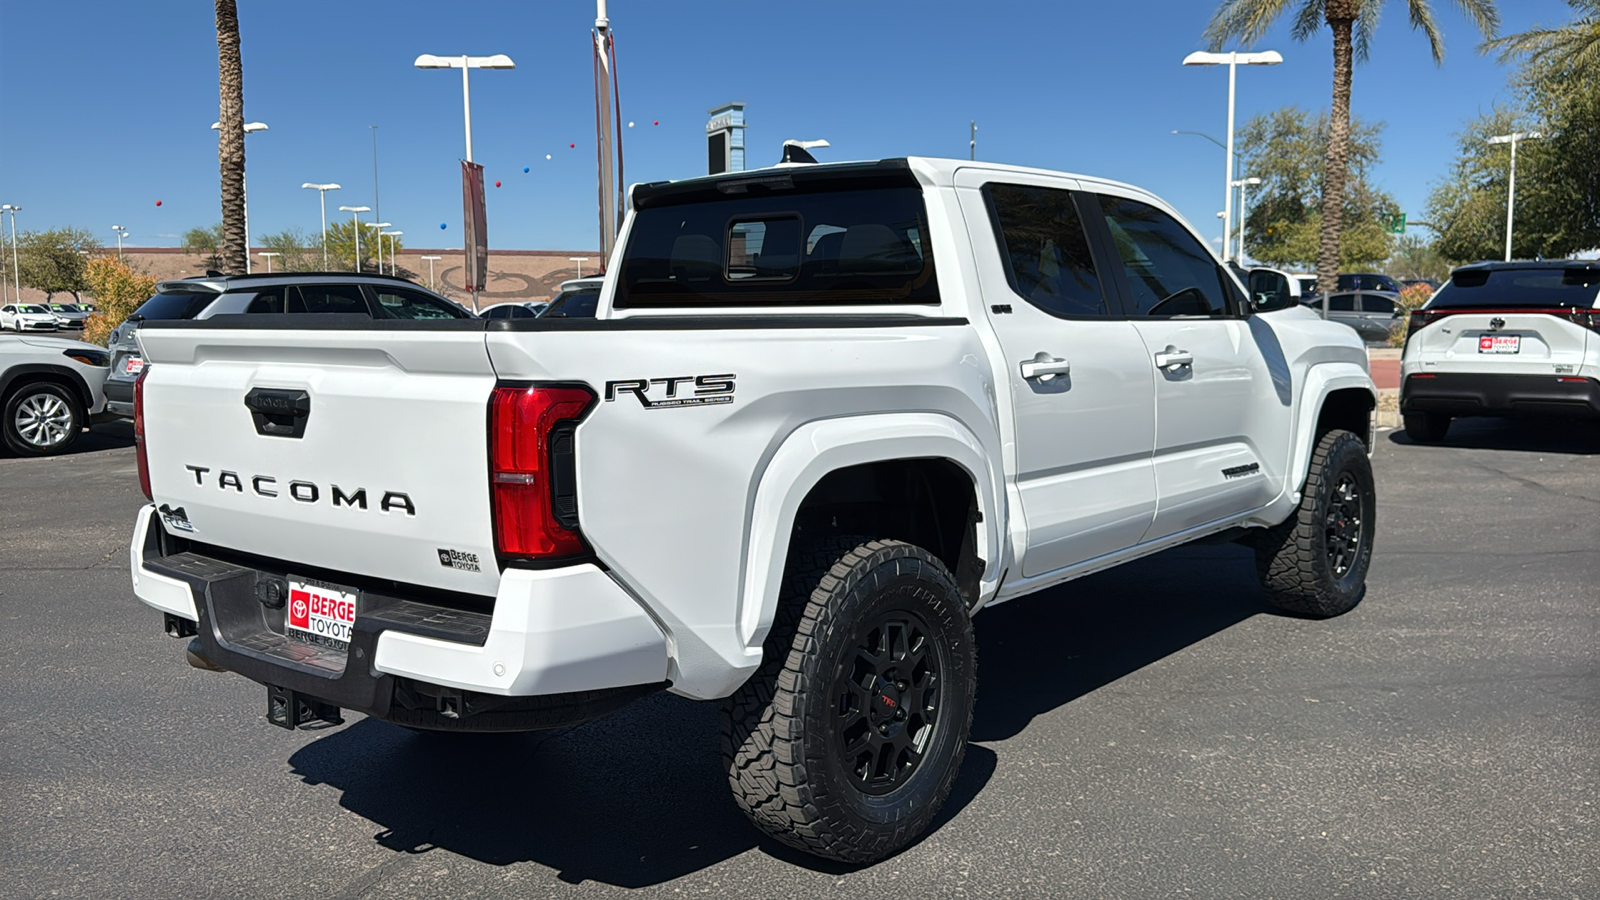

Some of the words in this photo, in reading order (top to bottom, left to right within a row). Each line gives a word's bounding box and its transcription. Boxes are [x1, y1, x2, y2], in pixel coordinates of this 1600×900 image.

[604, 374, 736, 406] RTS
[185, 464, 415, 515] TACOMA
[450, 549, 479, 563] BERGE
[453, 561, 481, 571] TOYOTA
[311, 593, 355, 622] BERGE
[310, 617, 353, 639] TOYOTA
[288, 629, 320, 644] BERGE
[323, 635, 350, 651] TOYOT
